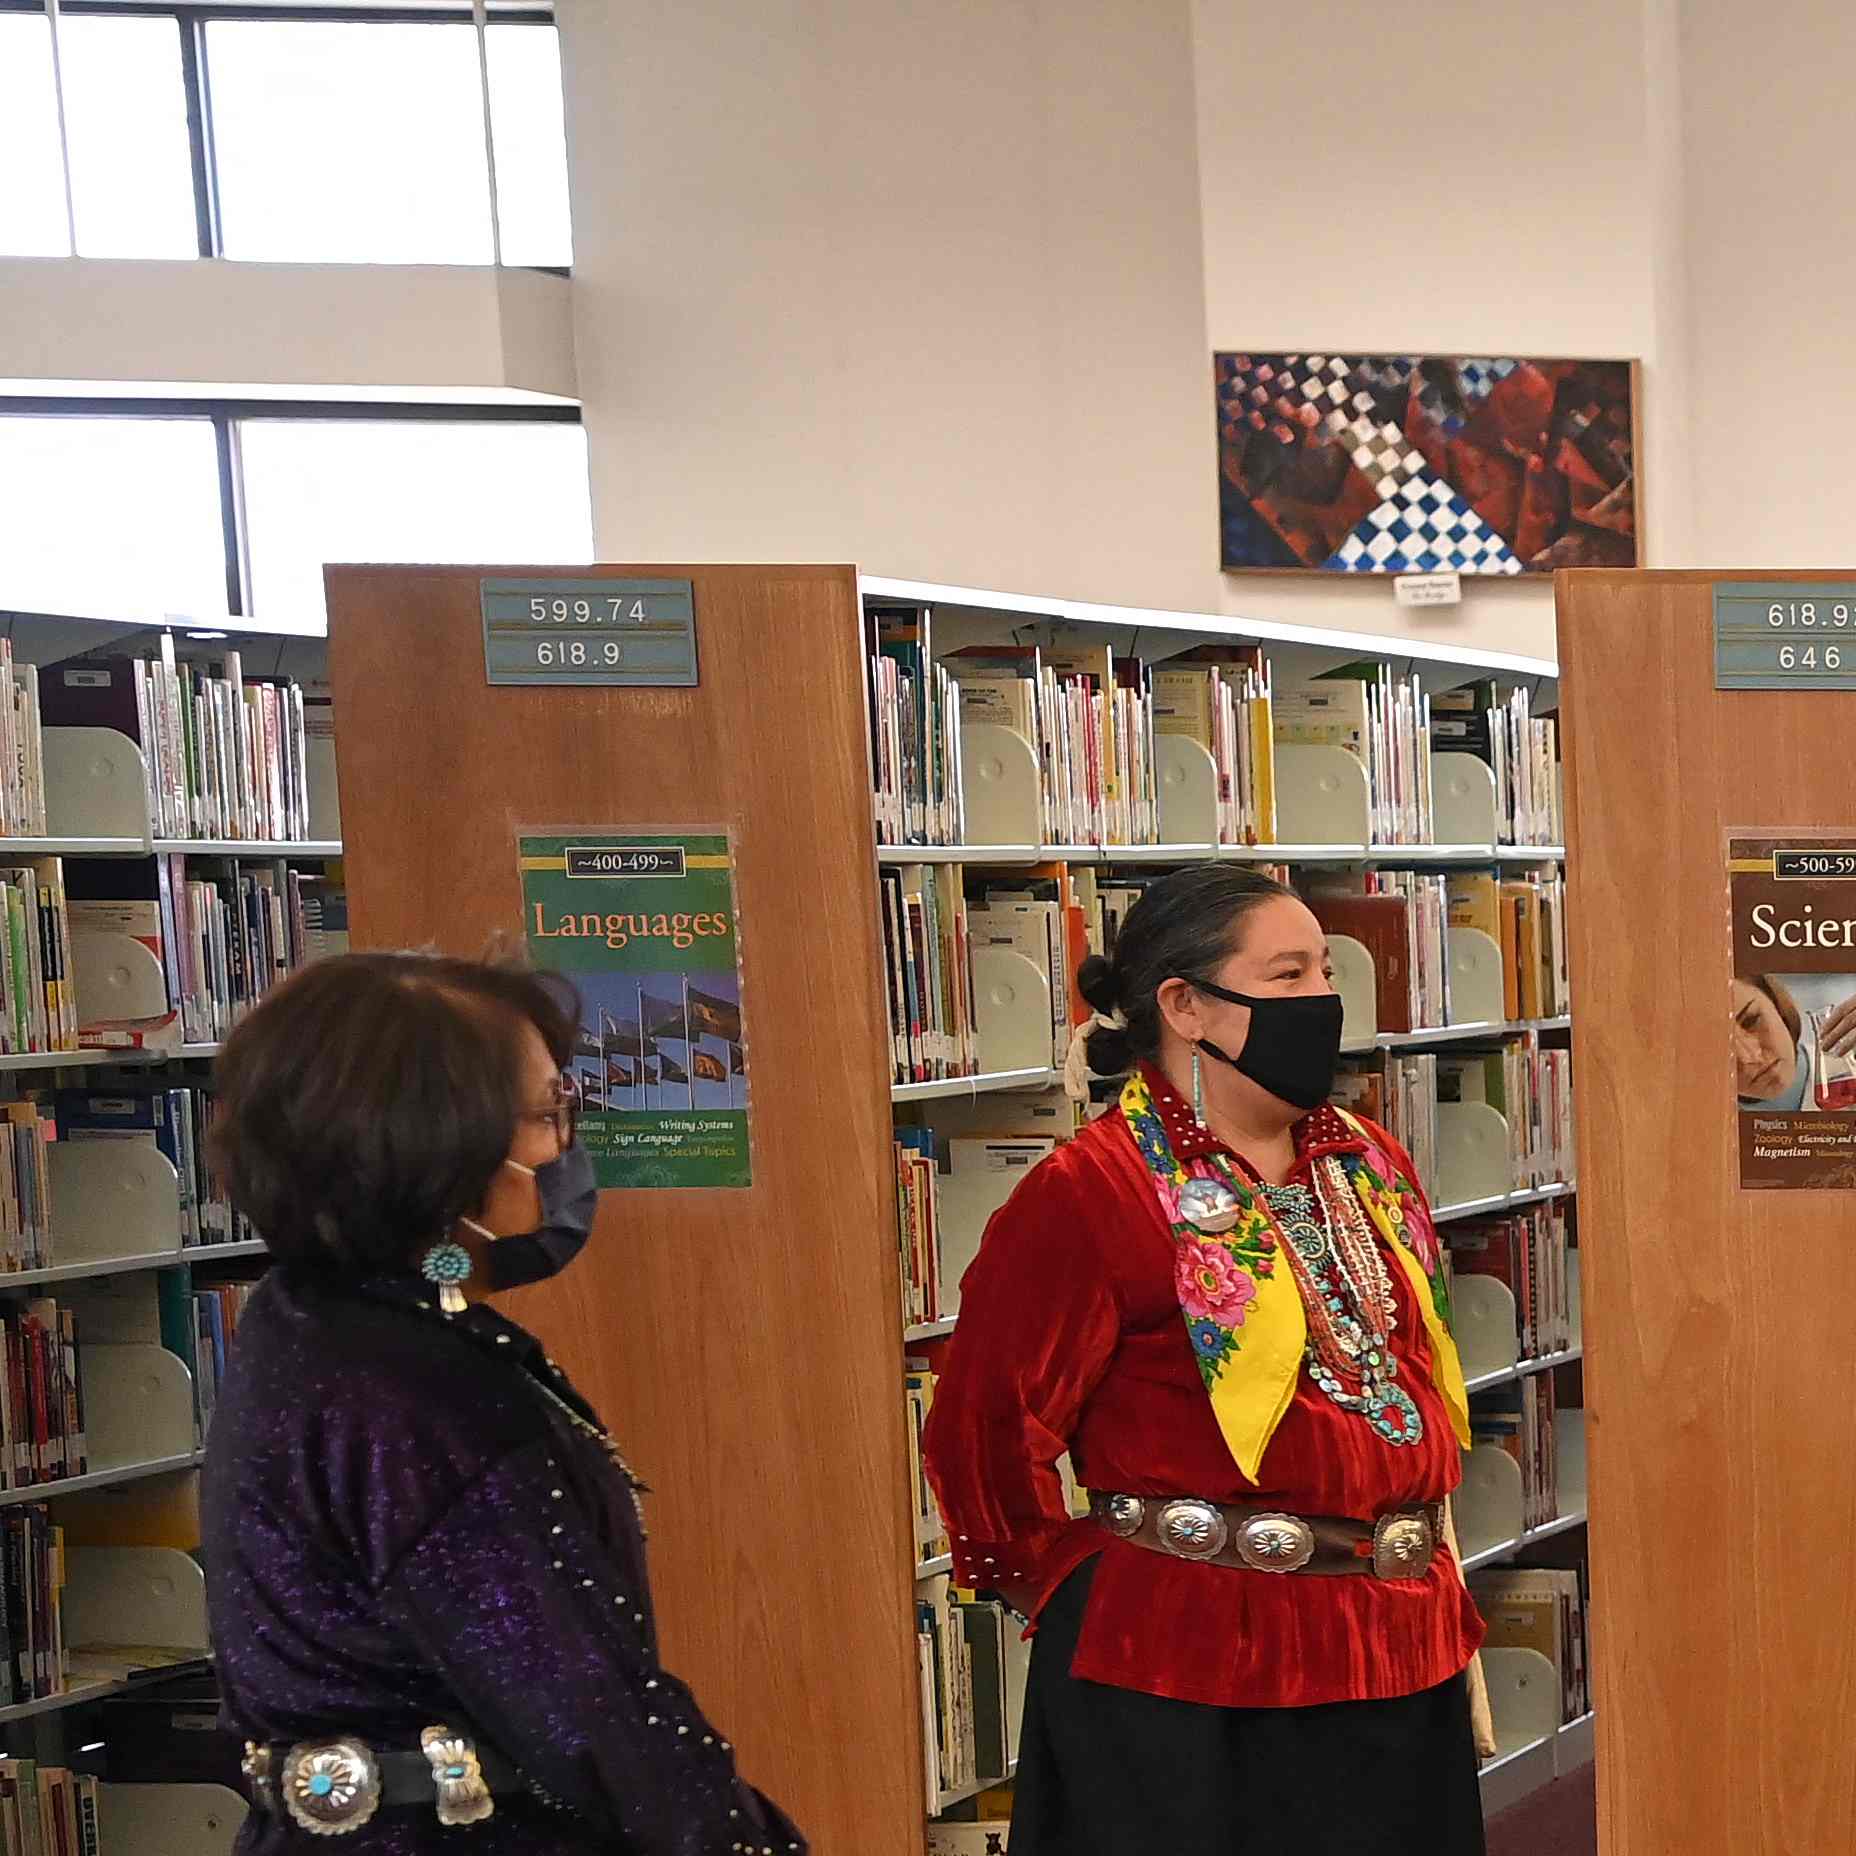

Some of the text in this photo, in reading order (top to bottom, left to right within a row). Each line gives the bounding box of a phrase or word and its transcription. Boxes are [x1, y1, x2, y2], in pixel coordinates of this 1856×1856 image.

[530, 599, 646, 623] 599.74
[537, 642, 620, 665] 618.9
[1779, 646, 1841, 669] 646
[533, 902, 728, 950] Languages
[659, 1119, 696, 1133] Writing
[697, 1119, 733, 1132] Systems
[1753, 1119, 1788, 1132] Physics
[613, 1133, 634, 1146] Sign
[637, 1133, 684, 1146] Language
[1753, 1134, 1793, 1146] Zoology
[1837, 1134, 1851, 1144] and
[663, 1147, 700, 1158] Special
[1753, 1146, 1811, 1159] Magnetism
